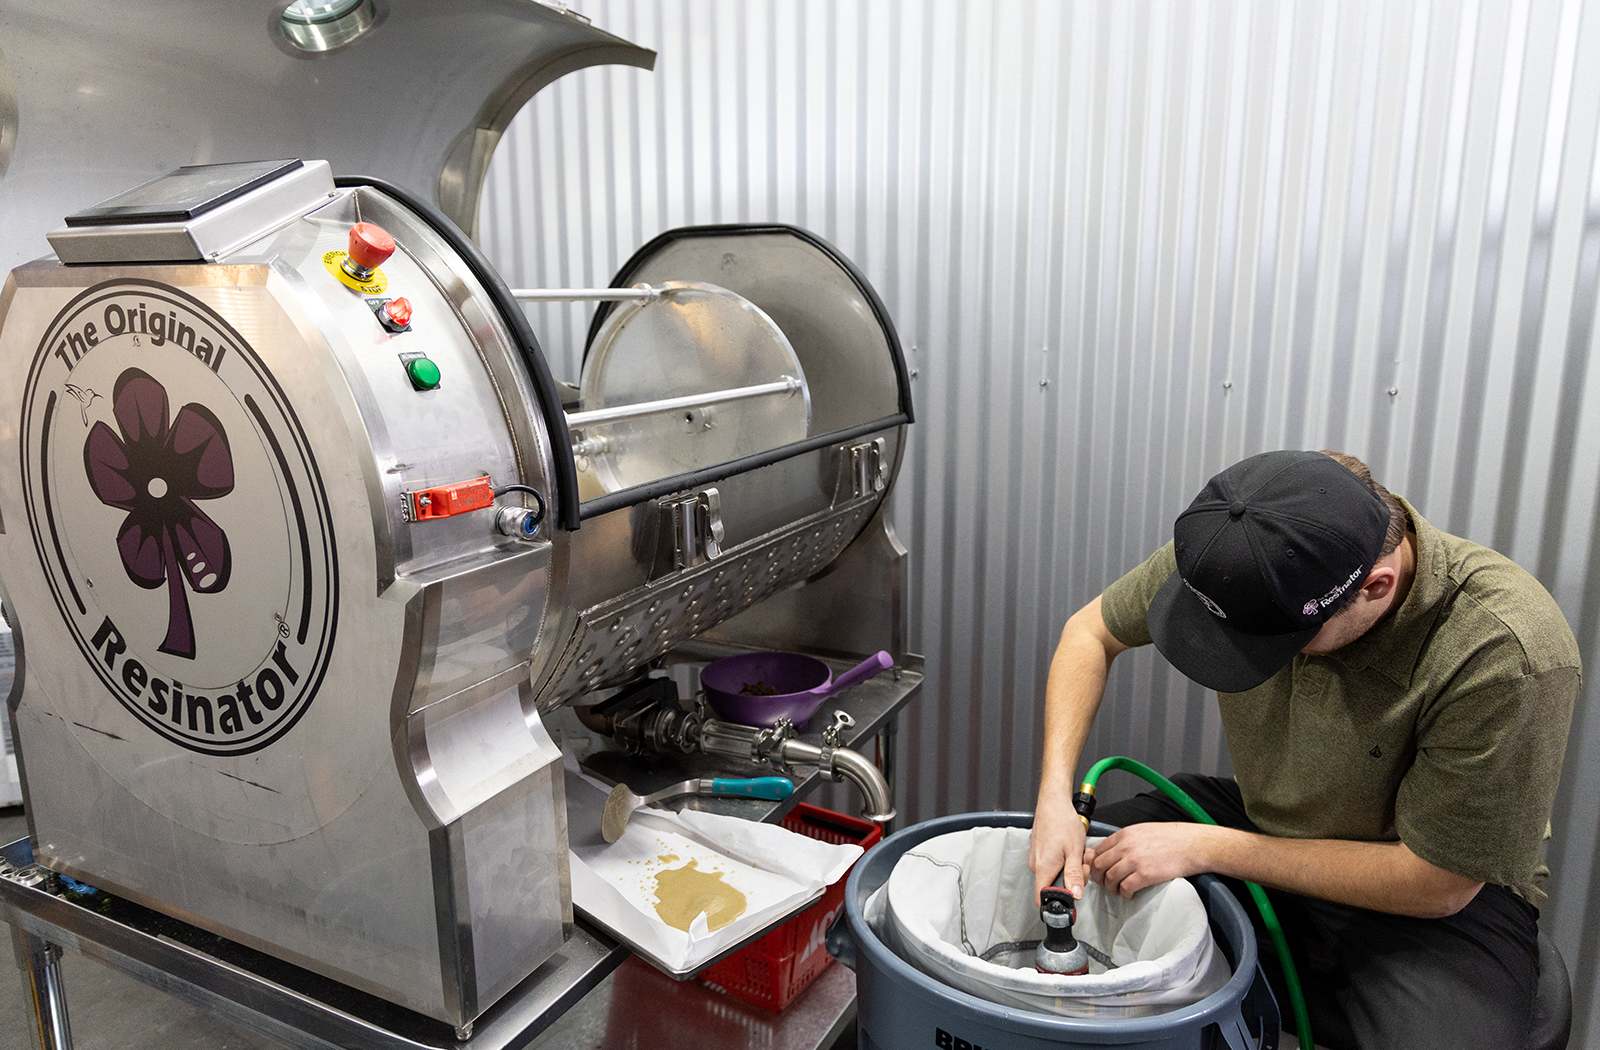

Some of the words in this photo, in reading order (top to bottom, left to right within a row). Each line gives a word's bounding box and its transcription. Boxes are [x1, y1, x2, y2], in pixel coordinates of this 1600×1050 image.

[54, 322, 99, 372] The
[104, 303, 226, 373] Original
[1320, 565, 1363, 608] Resinator
